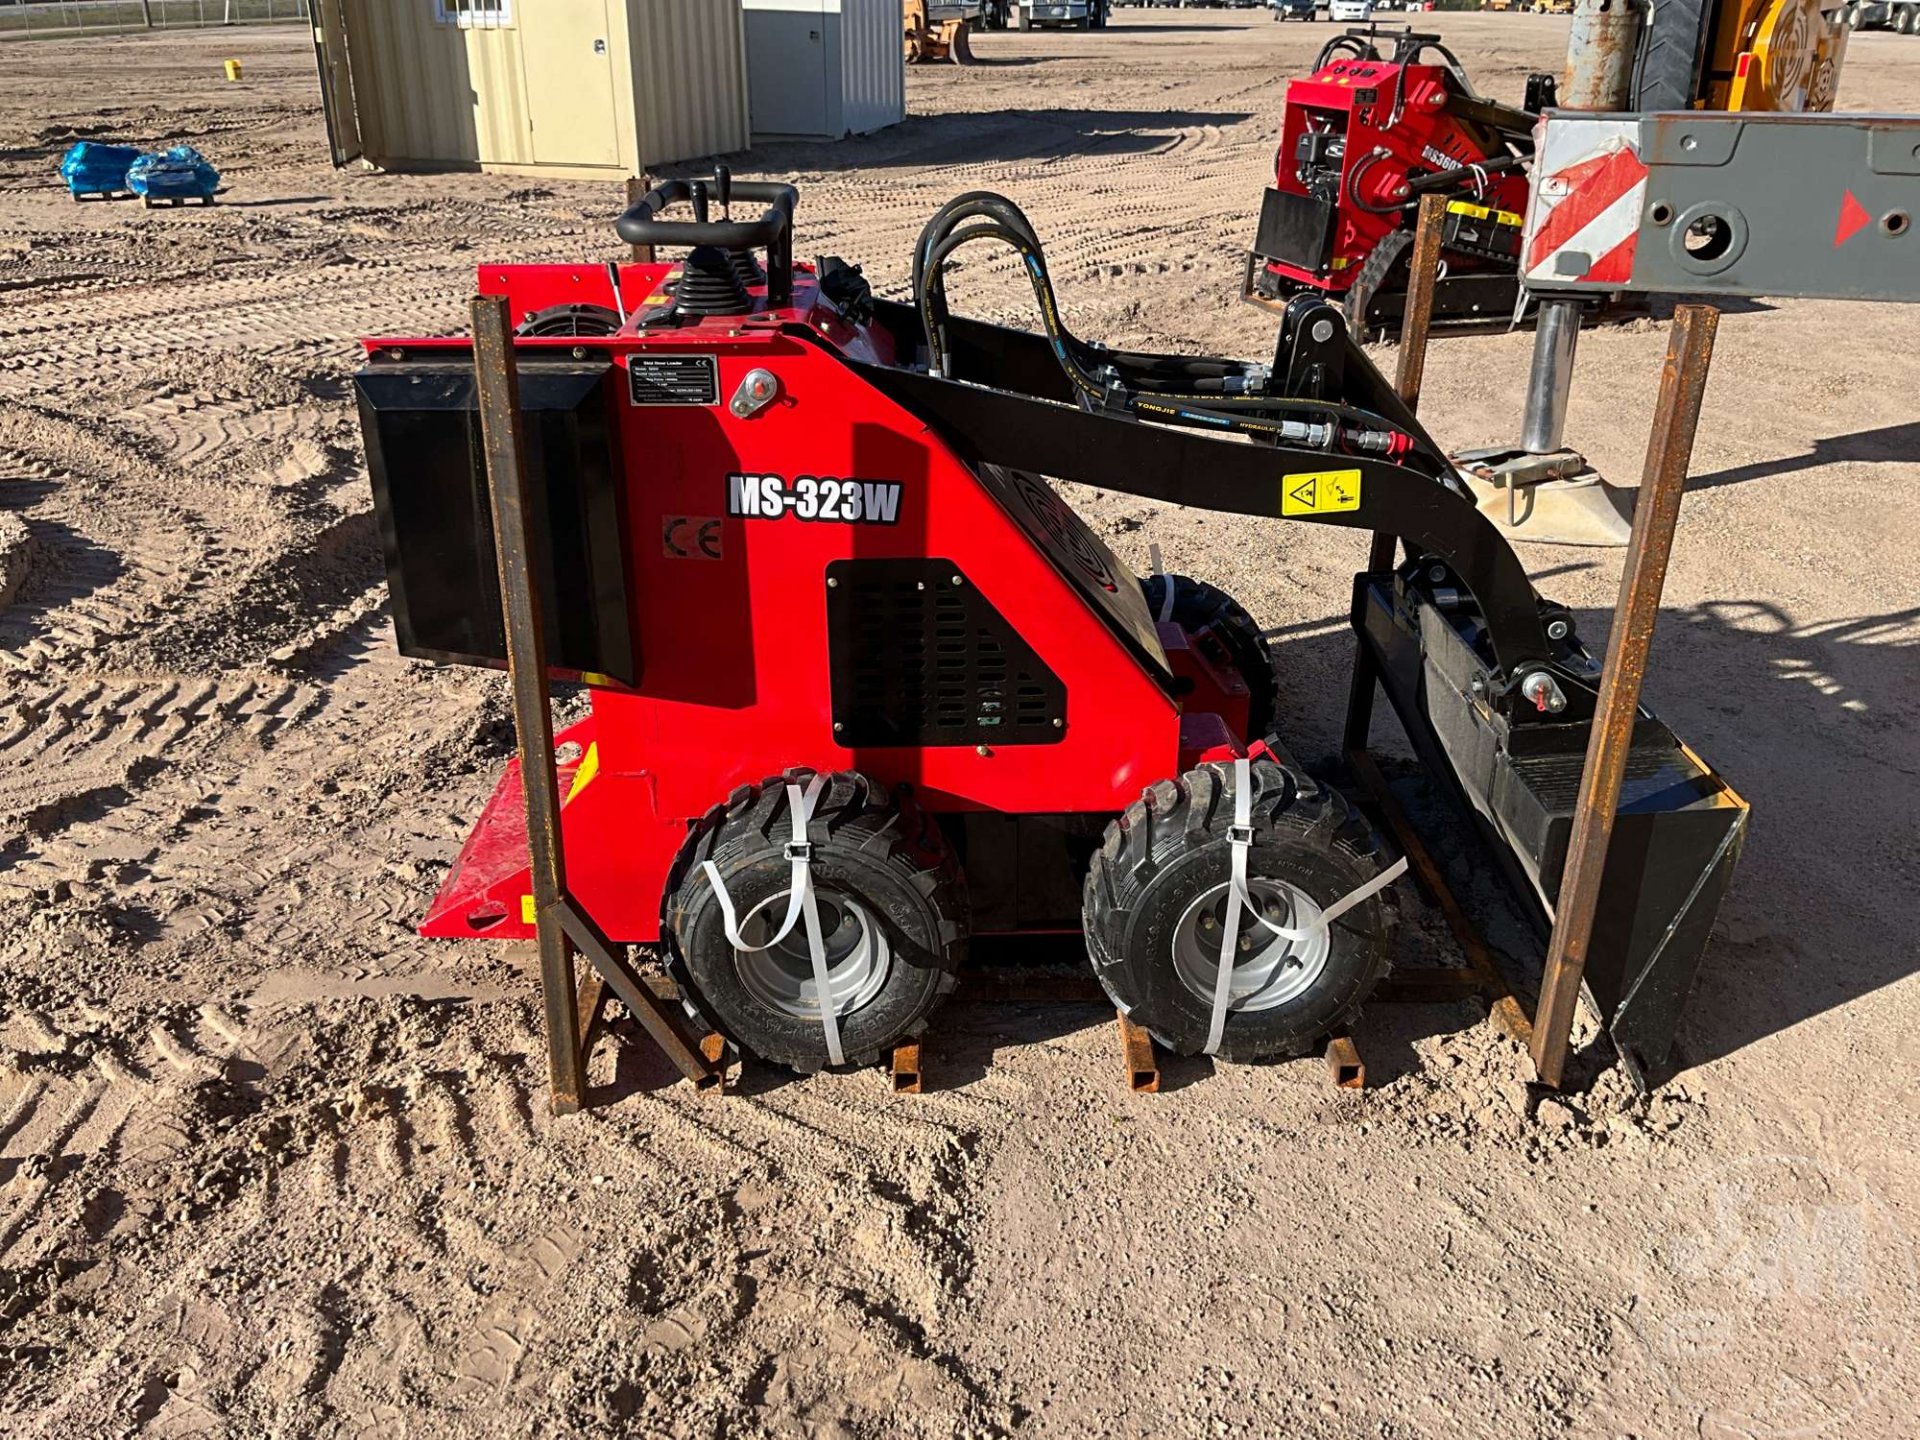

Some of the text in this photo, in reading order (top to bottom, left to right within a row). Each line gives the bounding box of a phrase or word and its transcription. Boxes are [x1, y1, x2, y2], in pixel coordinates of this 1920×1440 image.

[1137, 402, 1176, 415] YONGJIE
[1239, 422, 1277, 433] HYDRAULIC
[729, 476, 901, 523] MS-323W
[664, 518, 721, 558] CE
